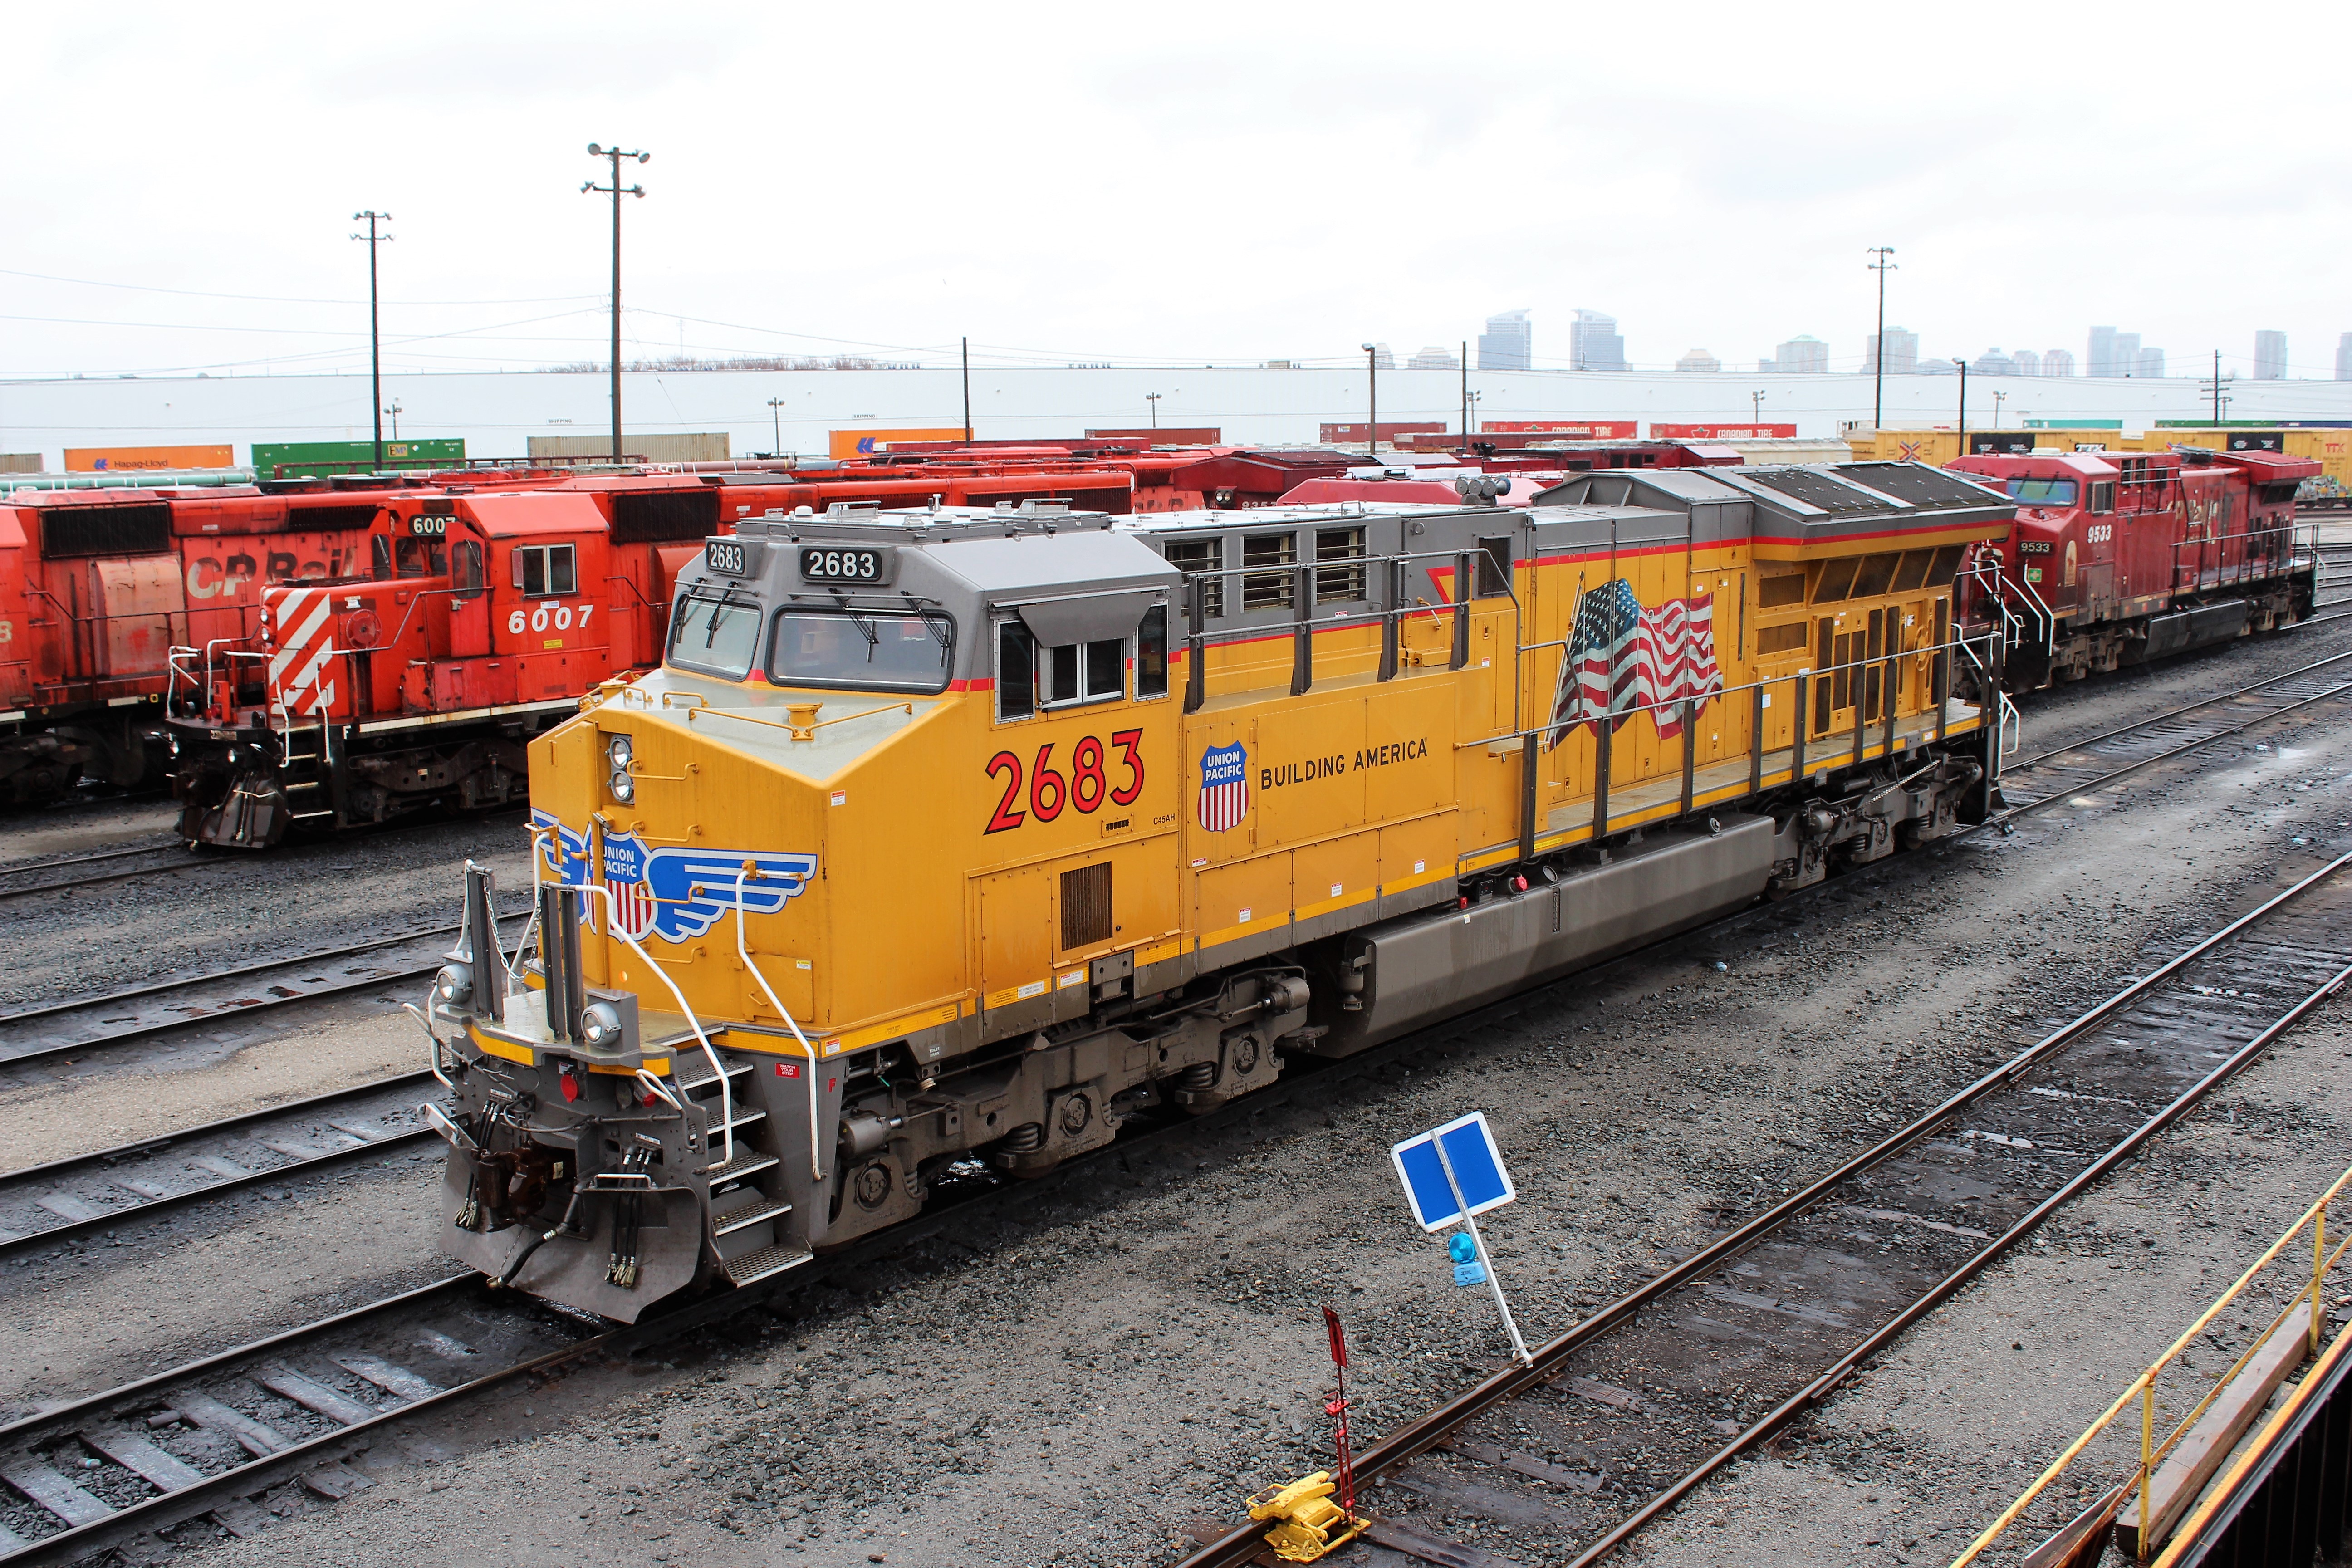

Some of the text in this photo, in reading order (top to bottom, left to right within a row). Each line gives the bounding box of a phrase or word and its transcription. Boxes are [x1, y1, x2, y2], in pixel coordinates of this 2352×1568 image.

[1595, 426, 1612, 436] TIRE
[1717, 429, 1773, 438] CANADIAN TIRE
[389, 444, 407, 456] EMP
[2075, 444, 2106, 452] TTX
[2325, 443, 2345, 453] TTX
[114, 459, 167, 468] Hapag-Lloyd
[2087, 524, 2112, 544] 9533
[2021, 542, 2050, 552] 9533
[710, 543, 743, 571] 2683
[808, 551, 876, 578] 2683
[187, 553, 257, 599] CP
[508, 604, 593, 634] 6007
[343, 725, 351, 740] F
[1207, 750, 1240, 768] UNION
[1205, 763, 1242, 782] PACIFIC
[1261, 754, 1345, 791] BUILDING
[983, 727, 1145, 836] 2683
[1153, 813, 1175, 825] C45AH
[828, 1078, 836, 1093] F
